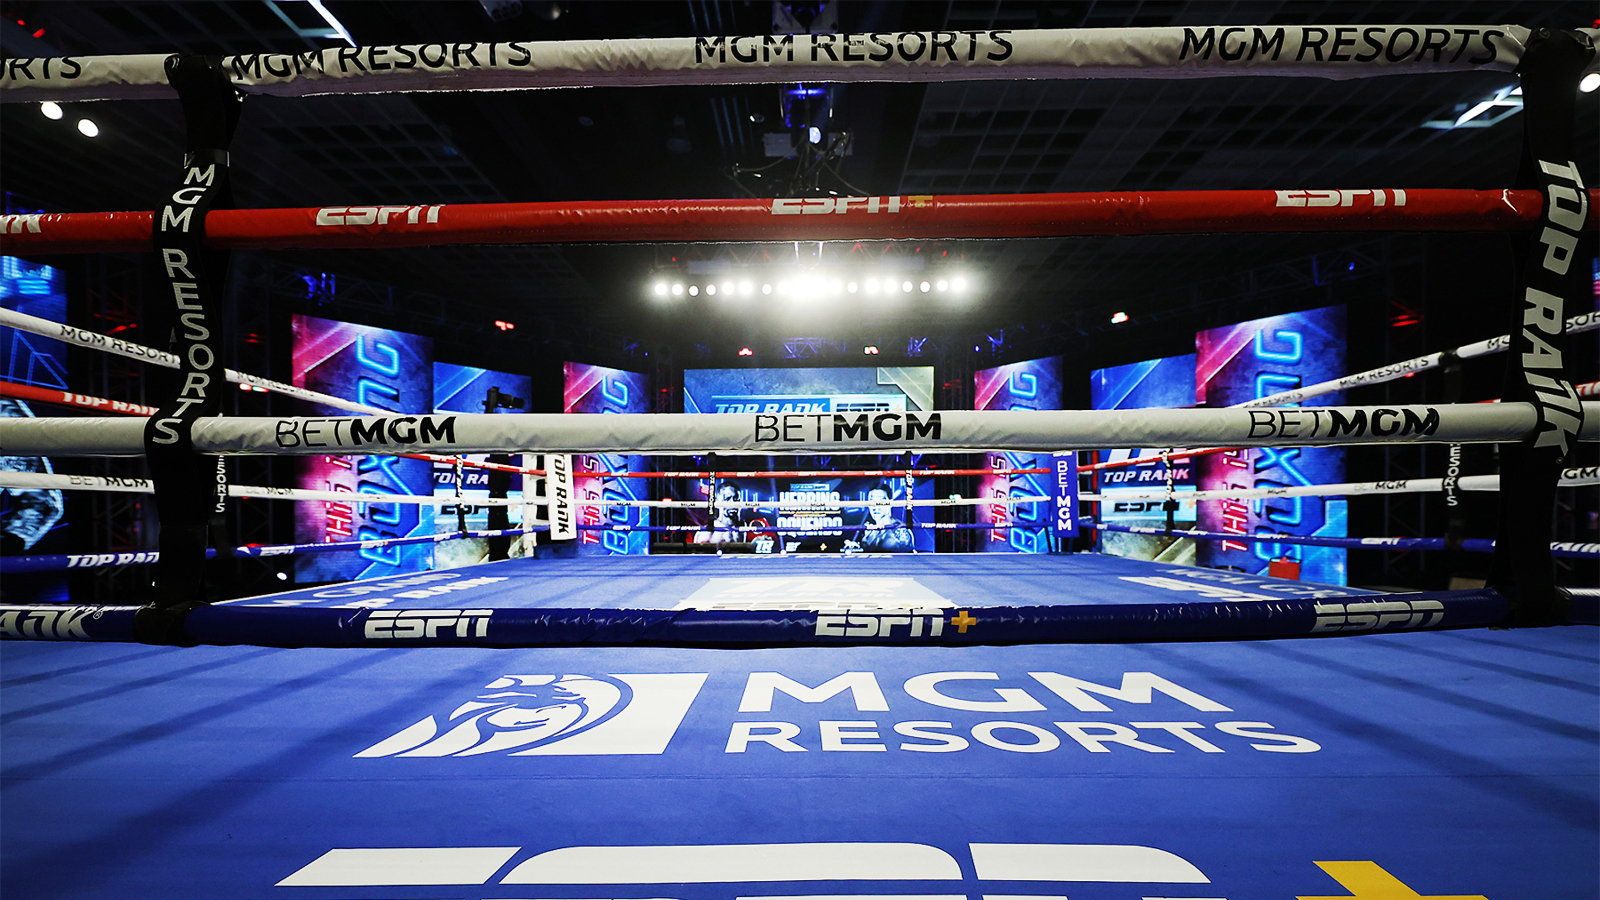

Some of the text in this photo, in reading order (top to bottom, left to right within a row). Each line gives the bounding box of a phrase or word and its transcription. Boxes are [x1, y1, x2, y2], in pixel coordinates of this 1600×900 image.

[231, 42, 532, 81] MGM RESORTS
[694, 30, 1013, 63] MGM RESORTS
[1179, 27, 1505, 65] MGM RESORTS
[1274, 189, 1407, 208] ESPN
[315, 204, 445, 227] ESPN
[152, 163, 215, 444] MGM RESORTS
[1522, 159, 1588, 458] TOP RANK
[60, 325, 106, 347] MGM
[63, 391, 109, 407] TOP
[275, 415, 457, 448] BETMGM
[754, 412, 942, 443] BETMGM
[1247, 408, 1441, 438] BETMGM
[1103, 470, 1137, 483] TOP
[1444, 446, 1461, 506] ESORTS
[556, 486, 570, 534] RANK
[1056, 460, 1073, 532] BETMGM
[67, 551, 160, 568] TOP RAN
[364, 609, 494, 639] ESPN
[1310, 599, 1445, 633] ESPN
[737, 671, 1235, 713] MGM
[723, 719, 1323, 754] RESORTS
